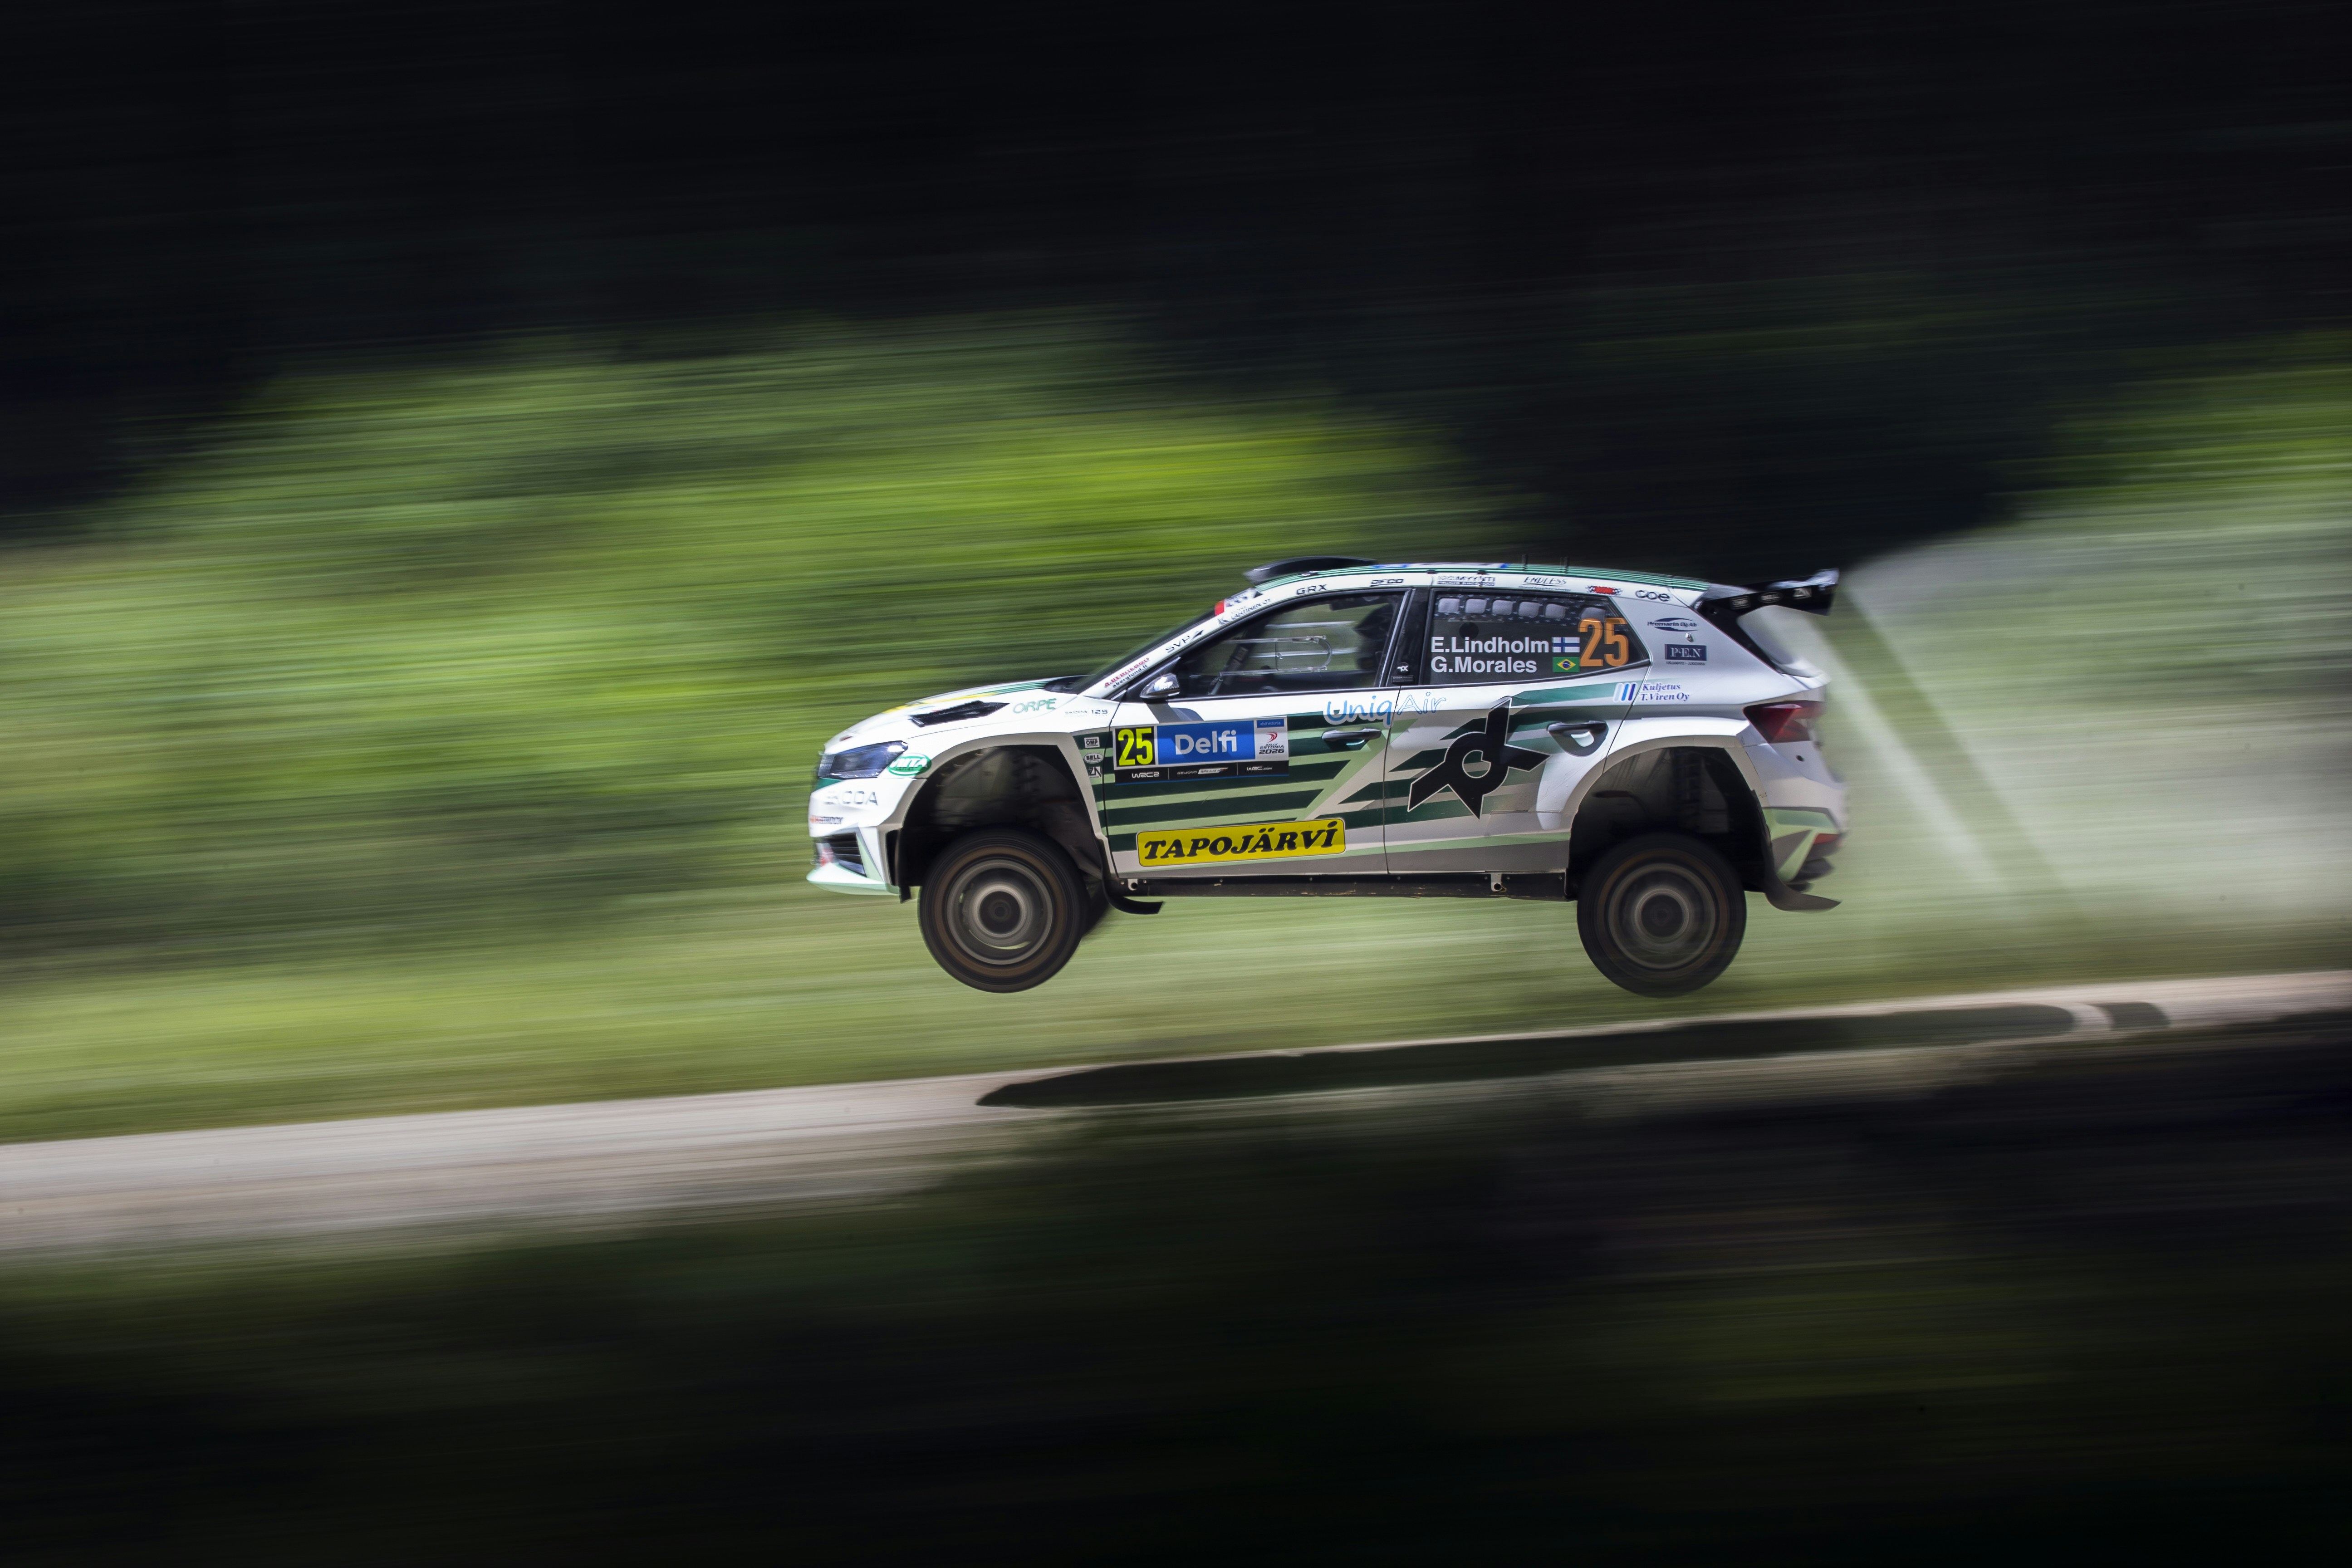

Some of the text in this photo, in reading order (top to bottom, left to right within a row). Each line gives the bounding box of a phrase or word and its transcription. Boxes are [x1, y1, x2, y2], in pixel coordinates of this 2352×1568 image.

[1296, 584, 1327, 595] GRX
[1431, 637, 1549, 653] E.Lindholm
[1578, 617, 1629, 667] 25
[1431, 656, 1537, 673] G.Morales
[1642, 683, 1681, 692] Kuljetus
[1676, 692, 1690, 702] Oy
[1013, 698, 1057, 714] ORPE
[1117, 727, 1153, 766] 25
[1175, 730, 1237, 755] Delfi
